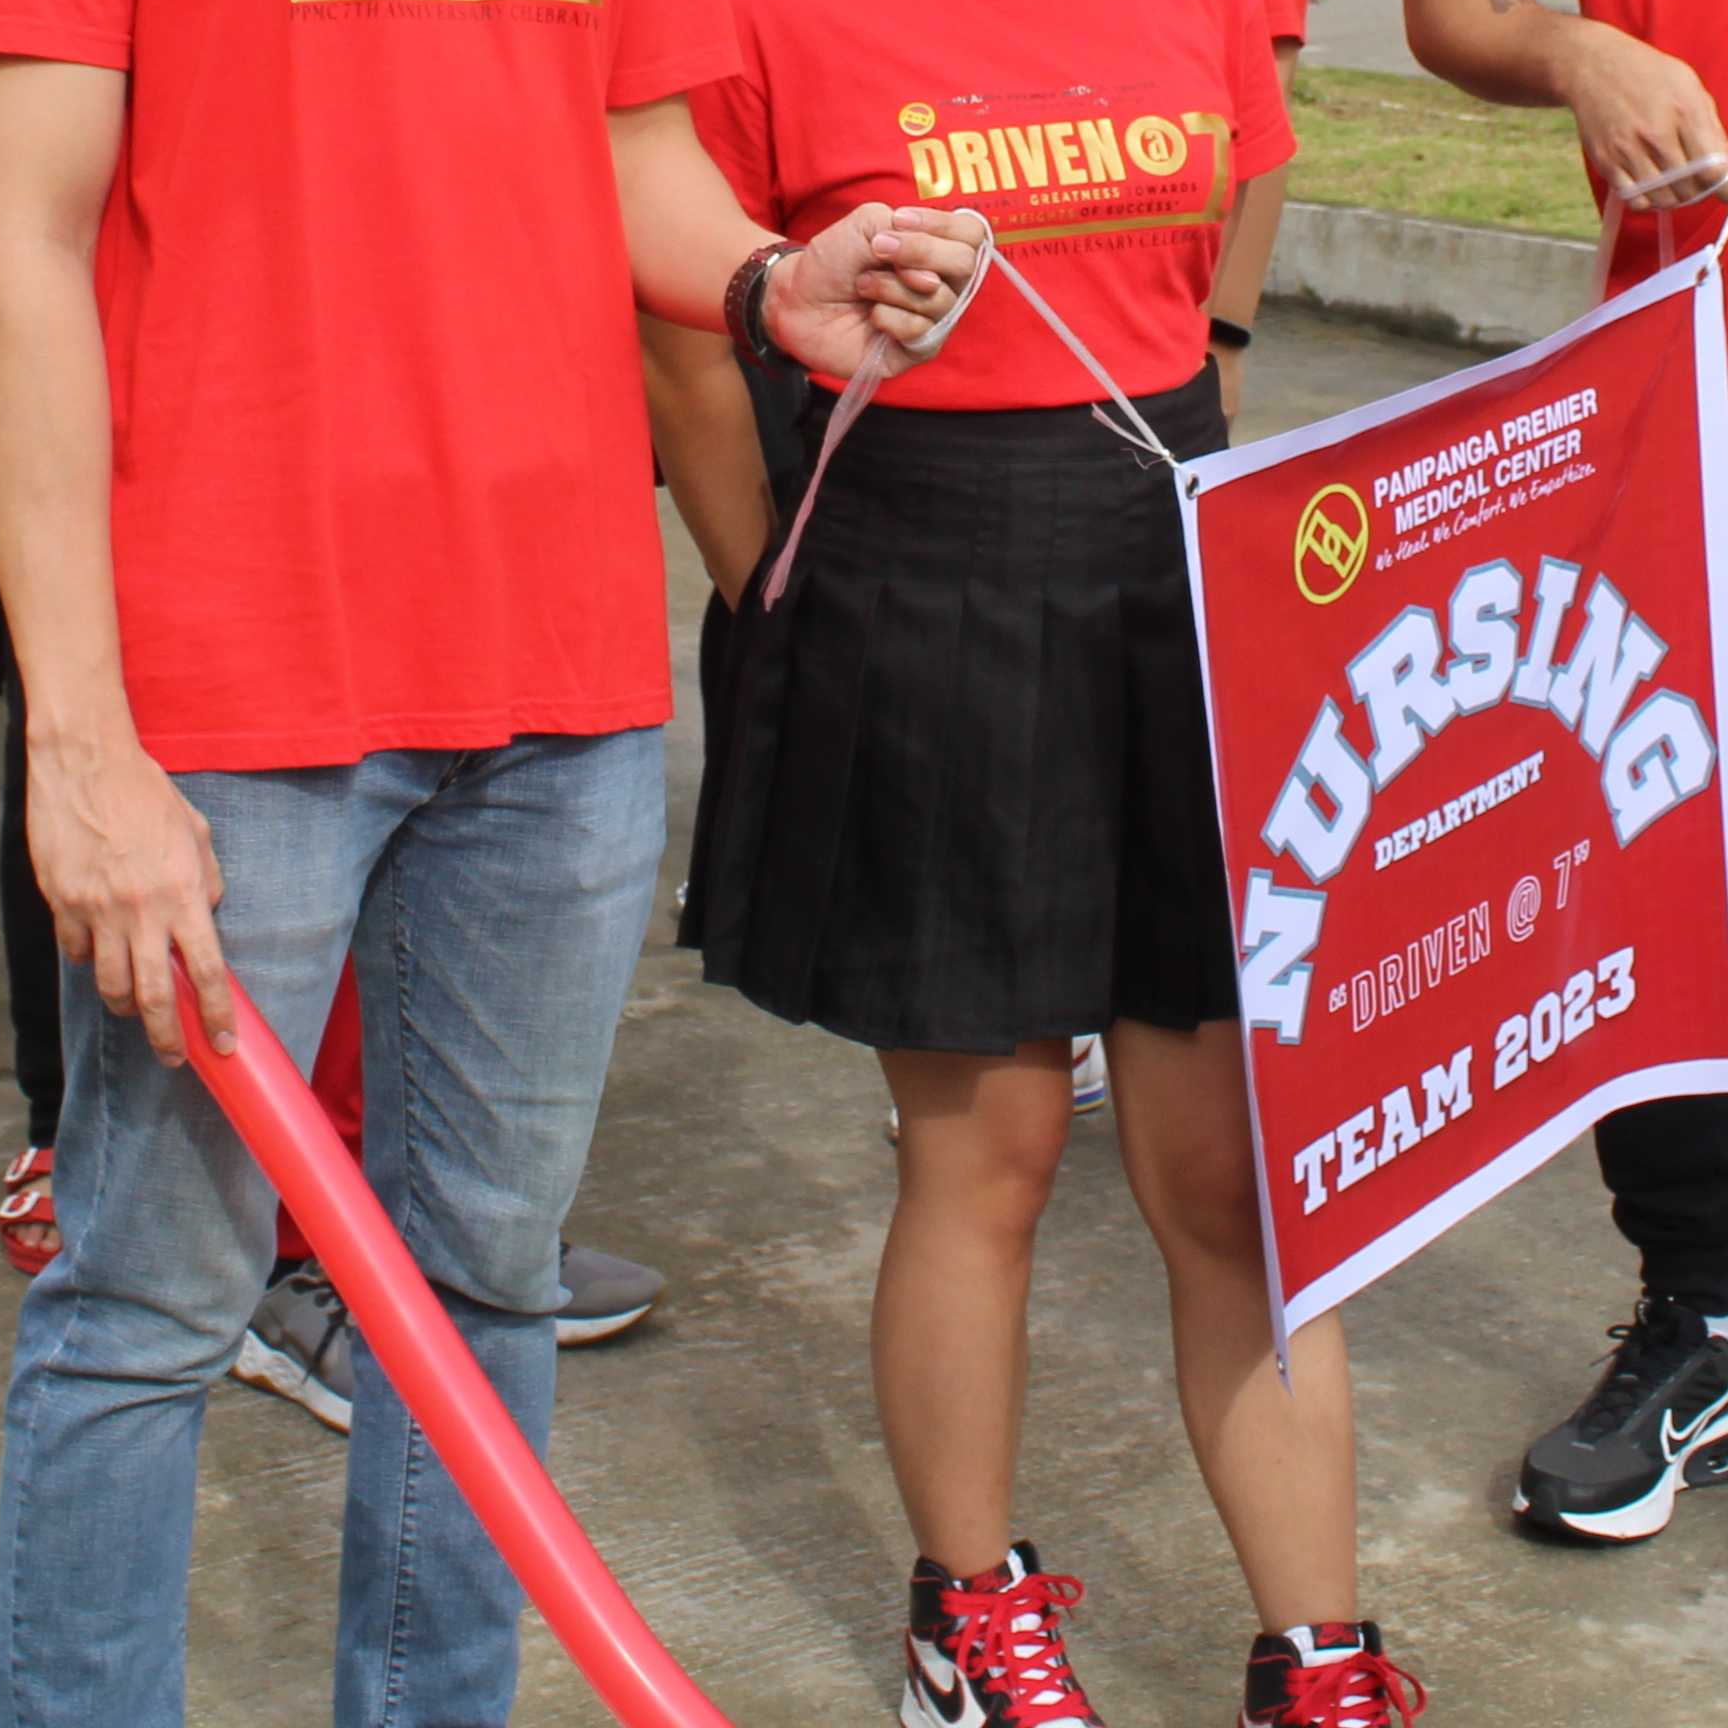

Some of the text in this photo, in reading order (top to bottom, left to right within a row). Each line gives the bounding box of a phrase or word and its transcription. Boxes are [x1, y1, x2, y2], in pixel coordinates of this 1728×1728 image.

[907, 118, 1127, 201] DRIVEN
[1028, 186, 1121, 208] GREATNESS
[1079, 205, 1099, 218] OF
[1373, 387, 1599, 509] PAMPANGA PREMIER
[1394, 428, 1583, 536] MEDICAL CENTER
[1394, 532, 1431, 562] Heal.
[1432, 525, 1452, 545] We
[1452, 496, 1507, 538] Comfort.
[1508, 488, 1528, 510] We
[1529, 462, 1597, 502] Empathize.
[1240, 553, 1718, 1046] NURSING
[1374, 750, 1545, 872] DEPARTMENT
[1506, 874, 1543, 943] @
[1292, 945, 1637, 1217] TEAM 2023
